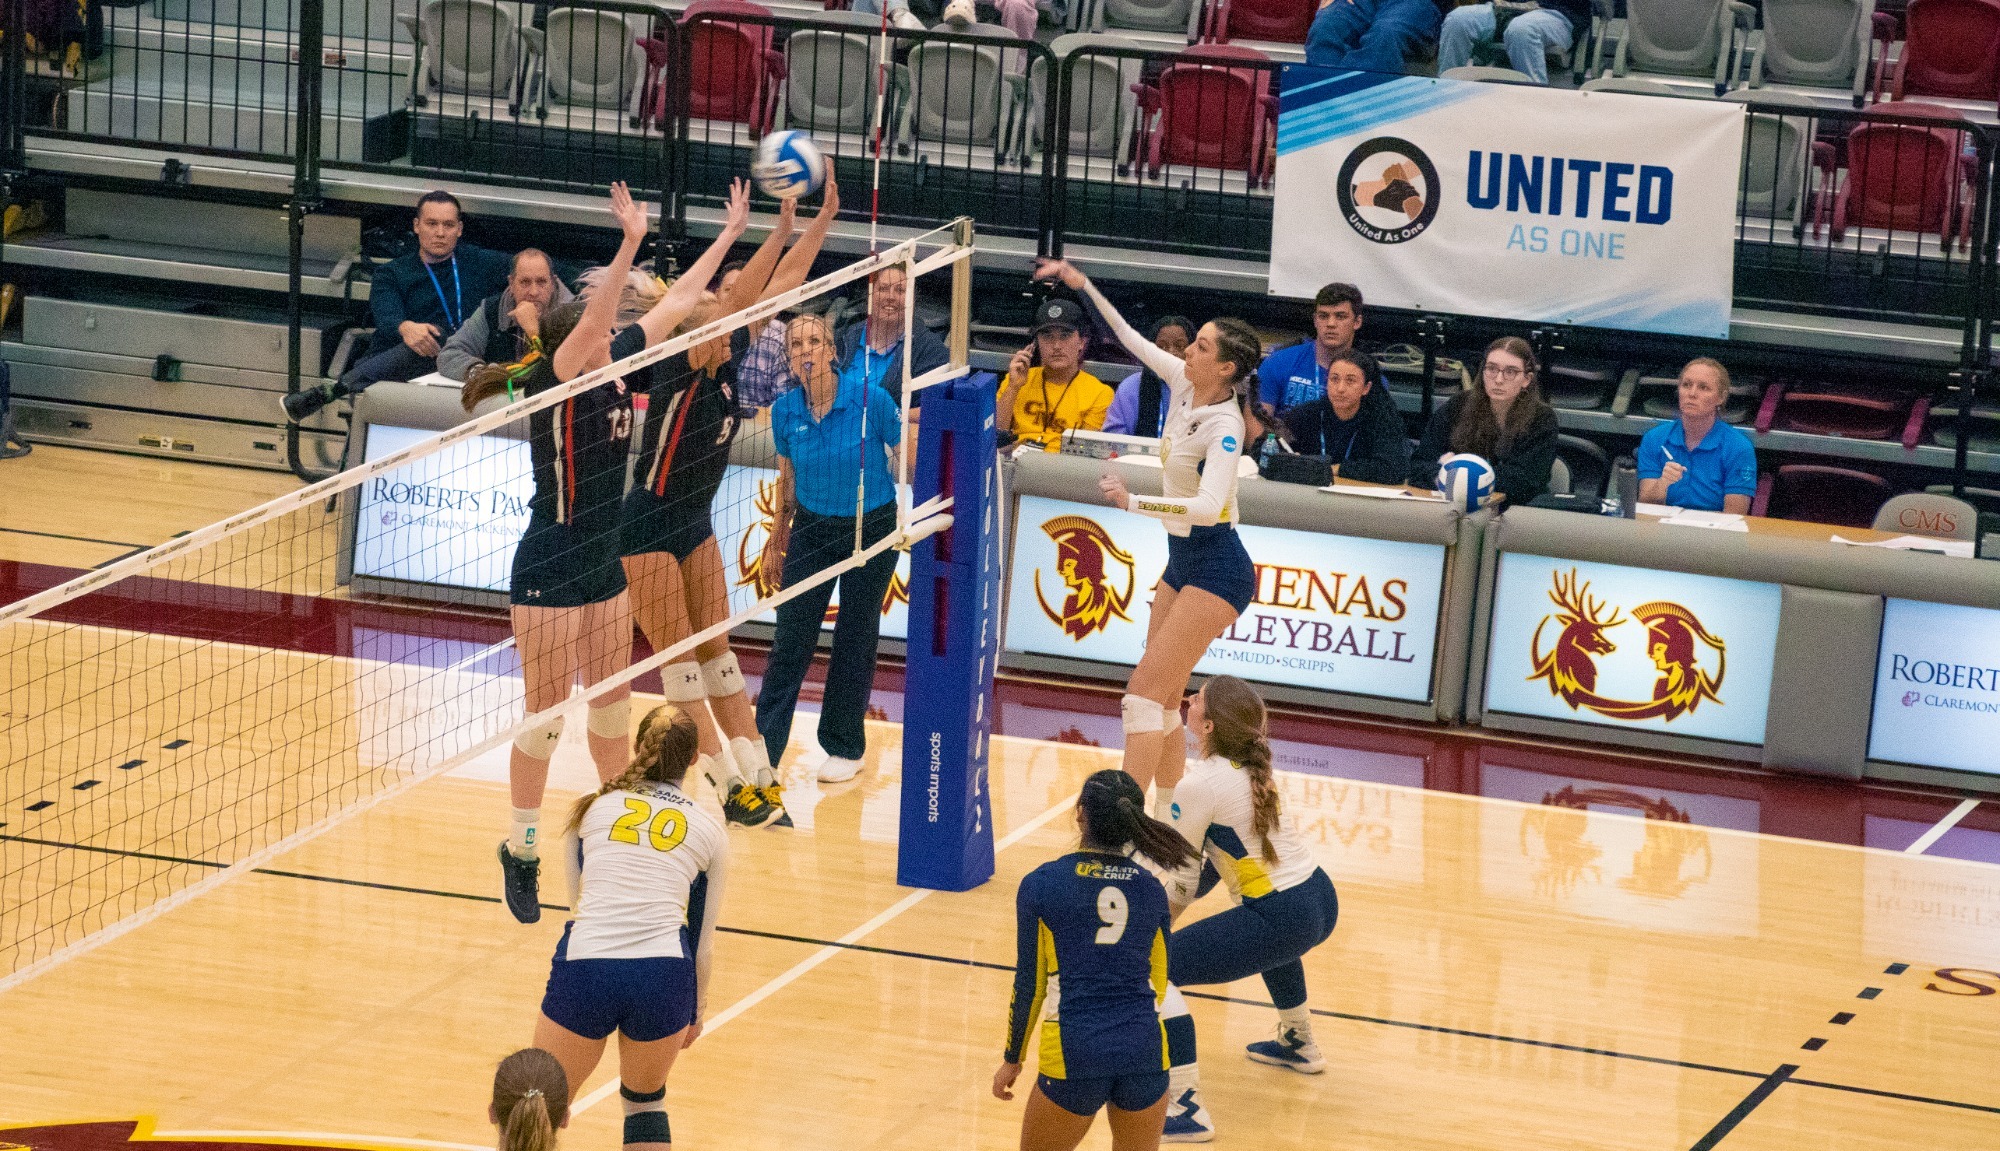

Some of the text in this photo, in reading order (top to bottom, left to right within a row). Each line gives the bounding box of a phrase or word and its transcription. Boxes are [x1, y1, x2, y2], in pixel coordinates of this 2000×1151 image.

[1467, 150, 1673, 225] UNITED
[1349, 213, 1424, 242] United As One
[1506, 224, 1626, 260] AS ONE
[374, 477, 481, 512] ROBERTS
[401, 513, 470, 531] CLAREMONT
[1900, 508, 1957, 533] CMS
[1252, 563, 1408, 622] ENAS
[1214, 613, 1416, 663] LEYBALL
[1232, 650, 1276, 665] MUDD
[1281, 657, 1335, 673] SCRIPPS
[1924, 694, 2000, 713] CLAREMON
[927, 732, 941, 823] sports imports
[608, 797, 688, 852] 20
[1075, 860, 1140, 878] UC SANTA
[1103, 872, 1133, 880] CRUZ
[1094, 886, 1129, 944] 9
